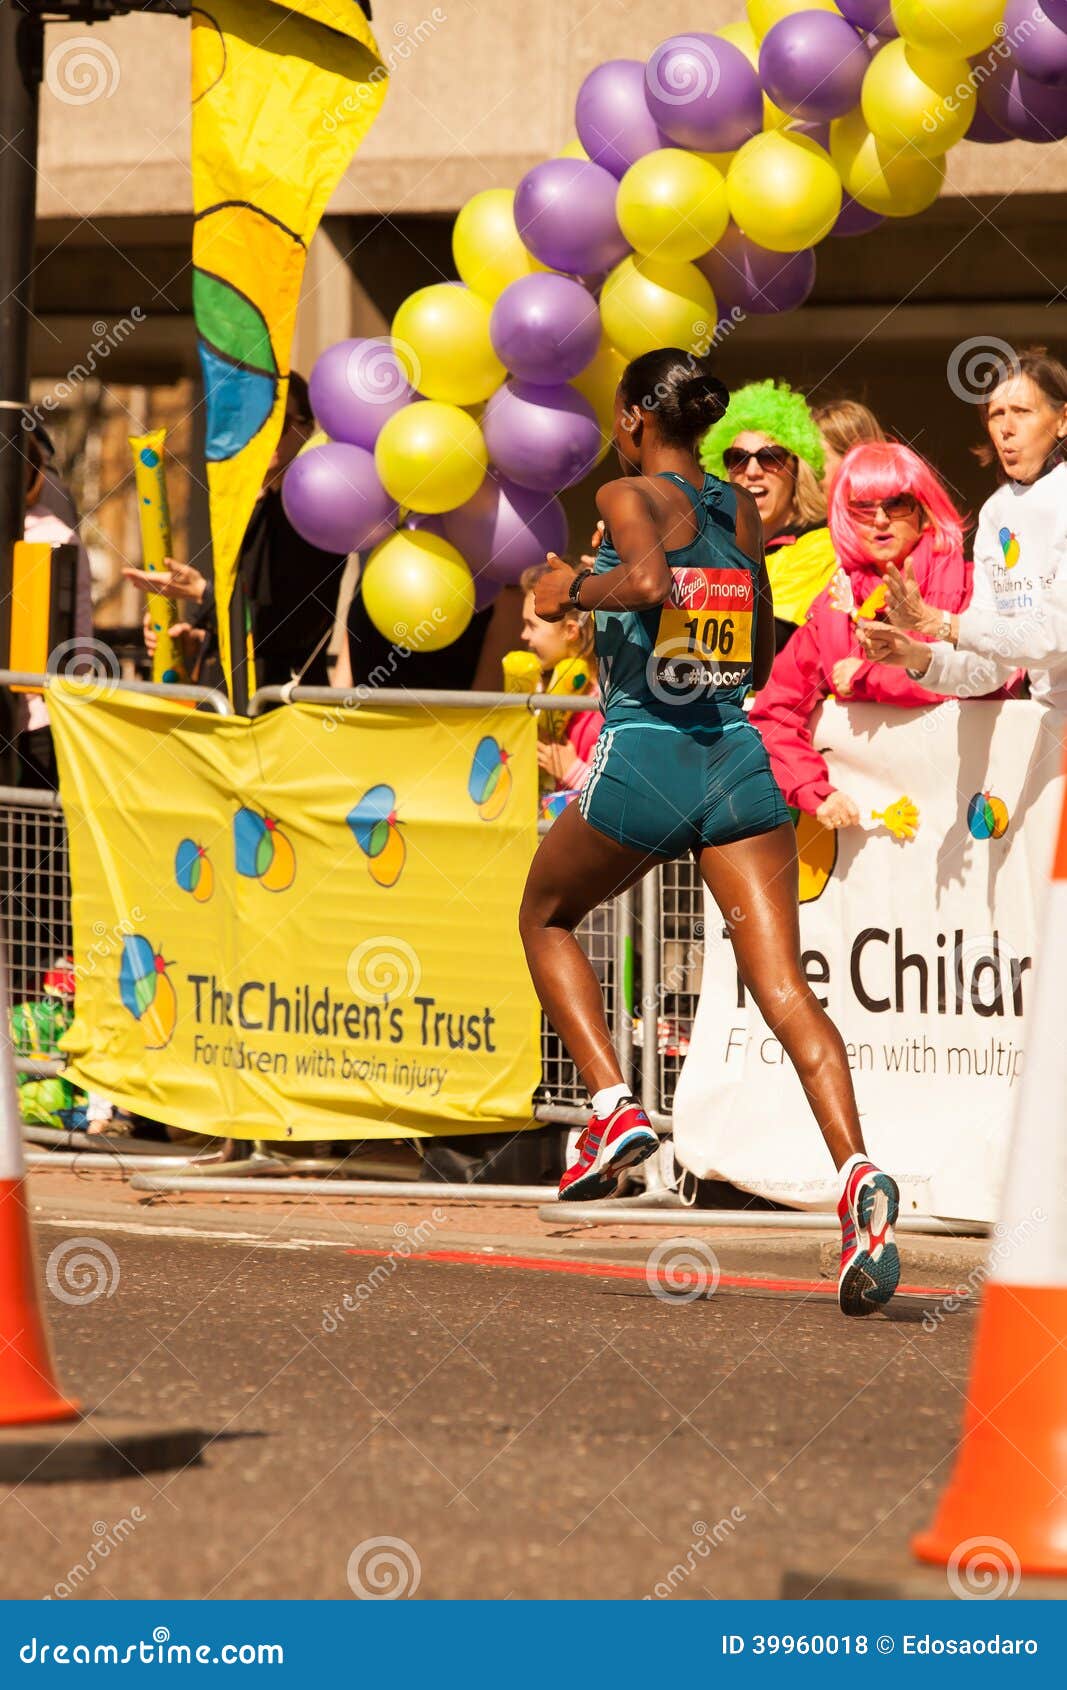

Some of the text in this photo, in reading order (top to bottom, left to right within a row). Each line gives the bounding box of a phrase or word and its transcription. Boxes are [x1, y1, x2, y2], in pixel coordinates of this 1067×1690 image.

[671, 568, 751, 608] Virgin money
[684, 617, 735, 655] 106
[187, 974, 496, 1053] The Children's Trust
[194, 1035, 219, 1065] For
[296, 1049, 335, 1078] with
[393, 1057, 448, 1097] injury
[883, 1035, 937, 1073] with
